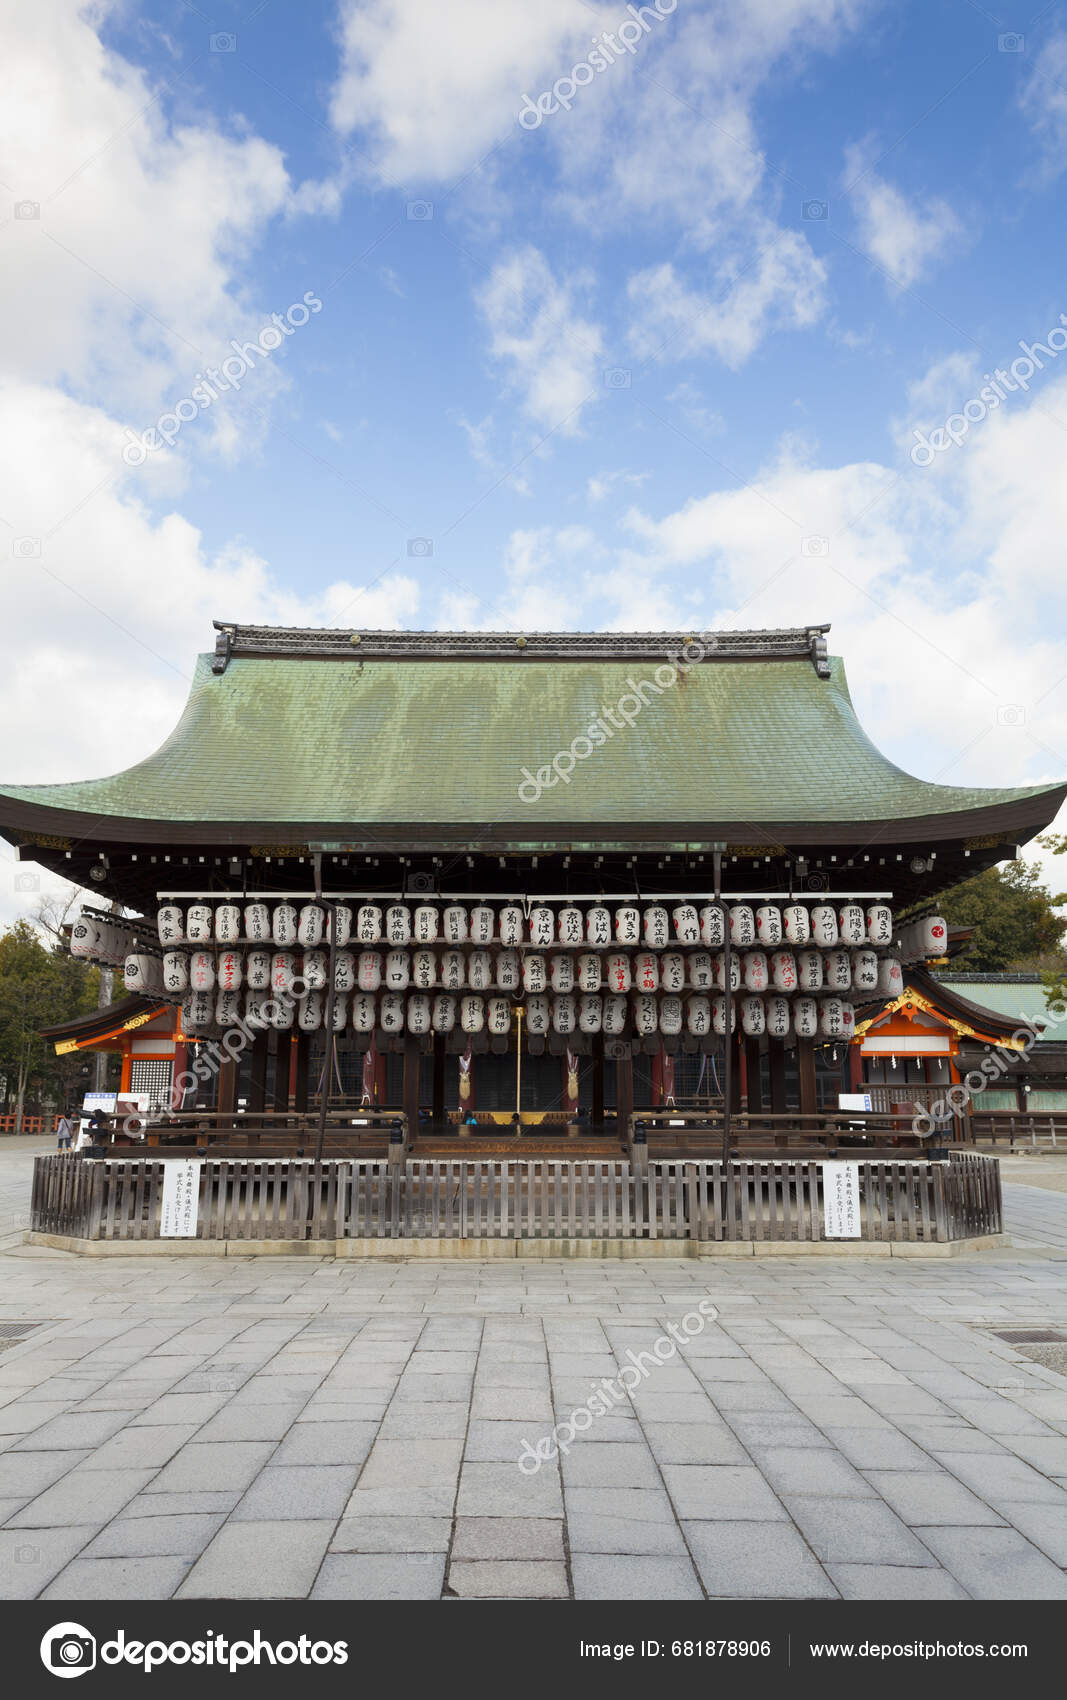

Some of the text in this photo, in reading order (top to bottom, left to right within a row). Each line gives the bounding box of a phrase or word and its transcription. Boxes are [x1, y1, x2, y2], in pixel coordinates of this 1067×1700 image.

[681, 908, 698, 941] 浜作
[822, 910, 834, 941] みやけ
[392, 955, 403, 981] 川口
